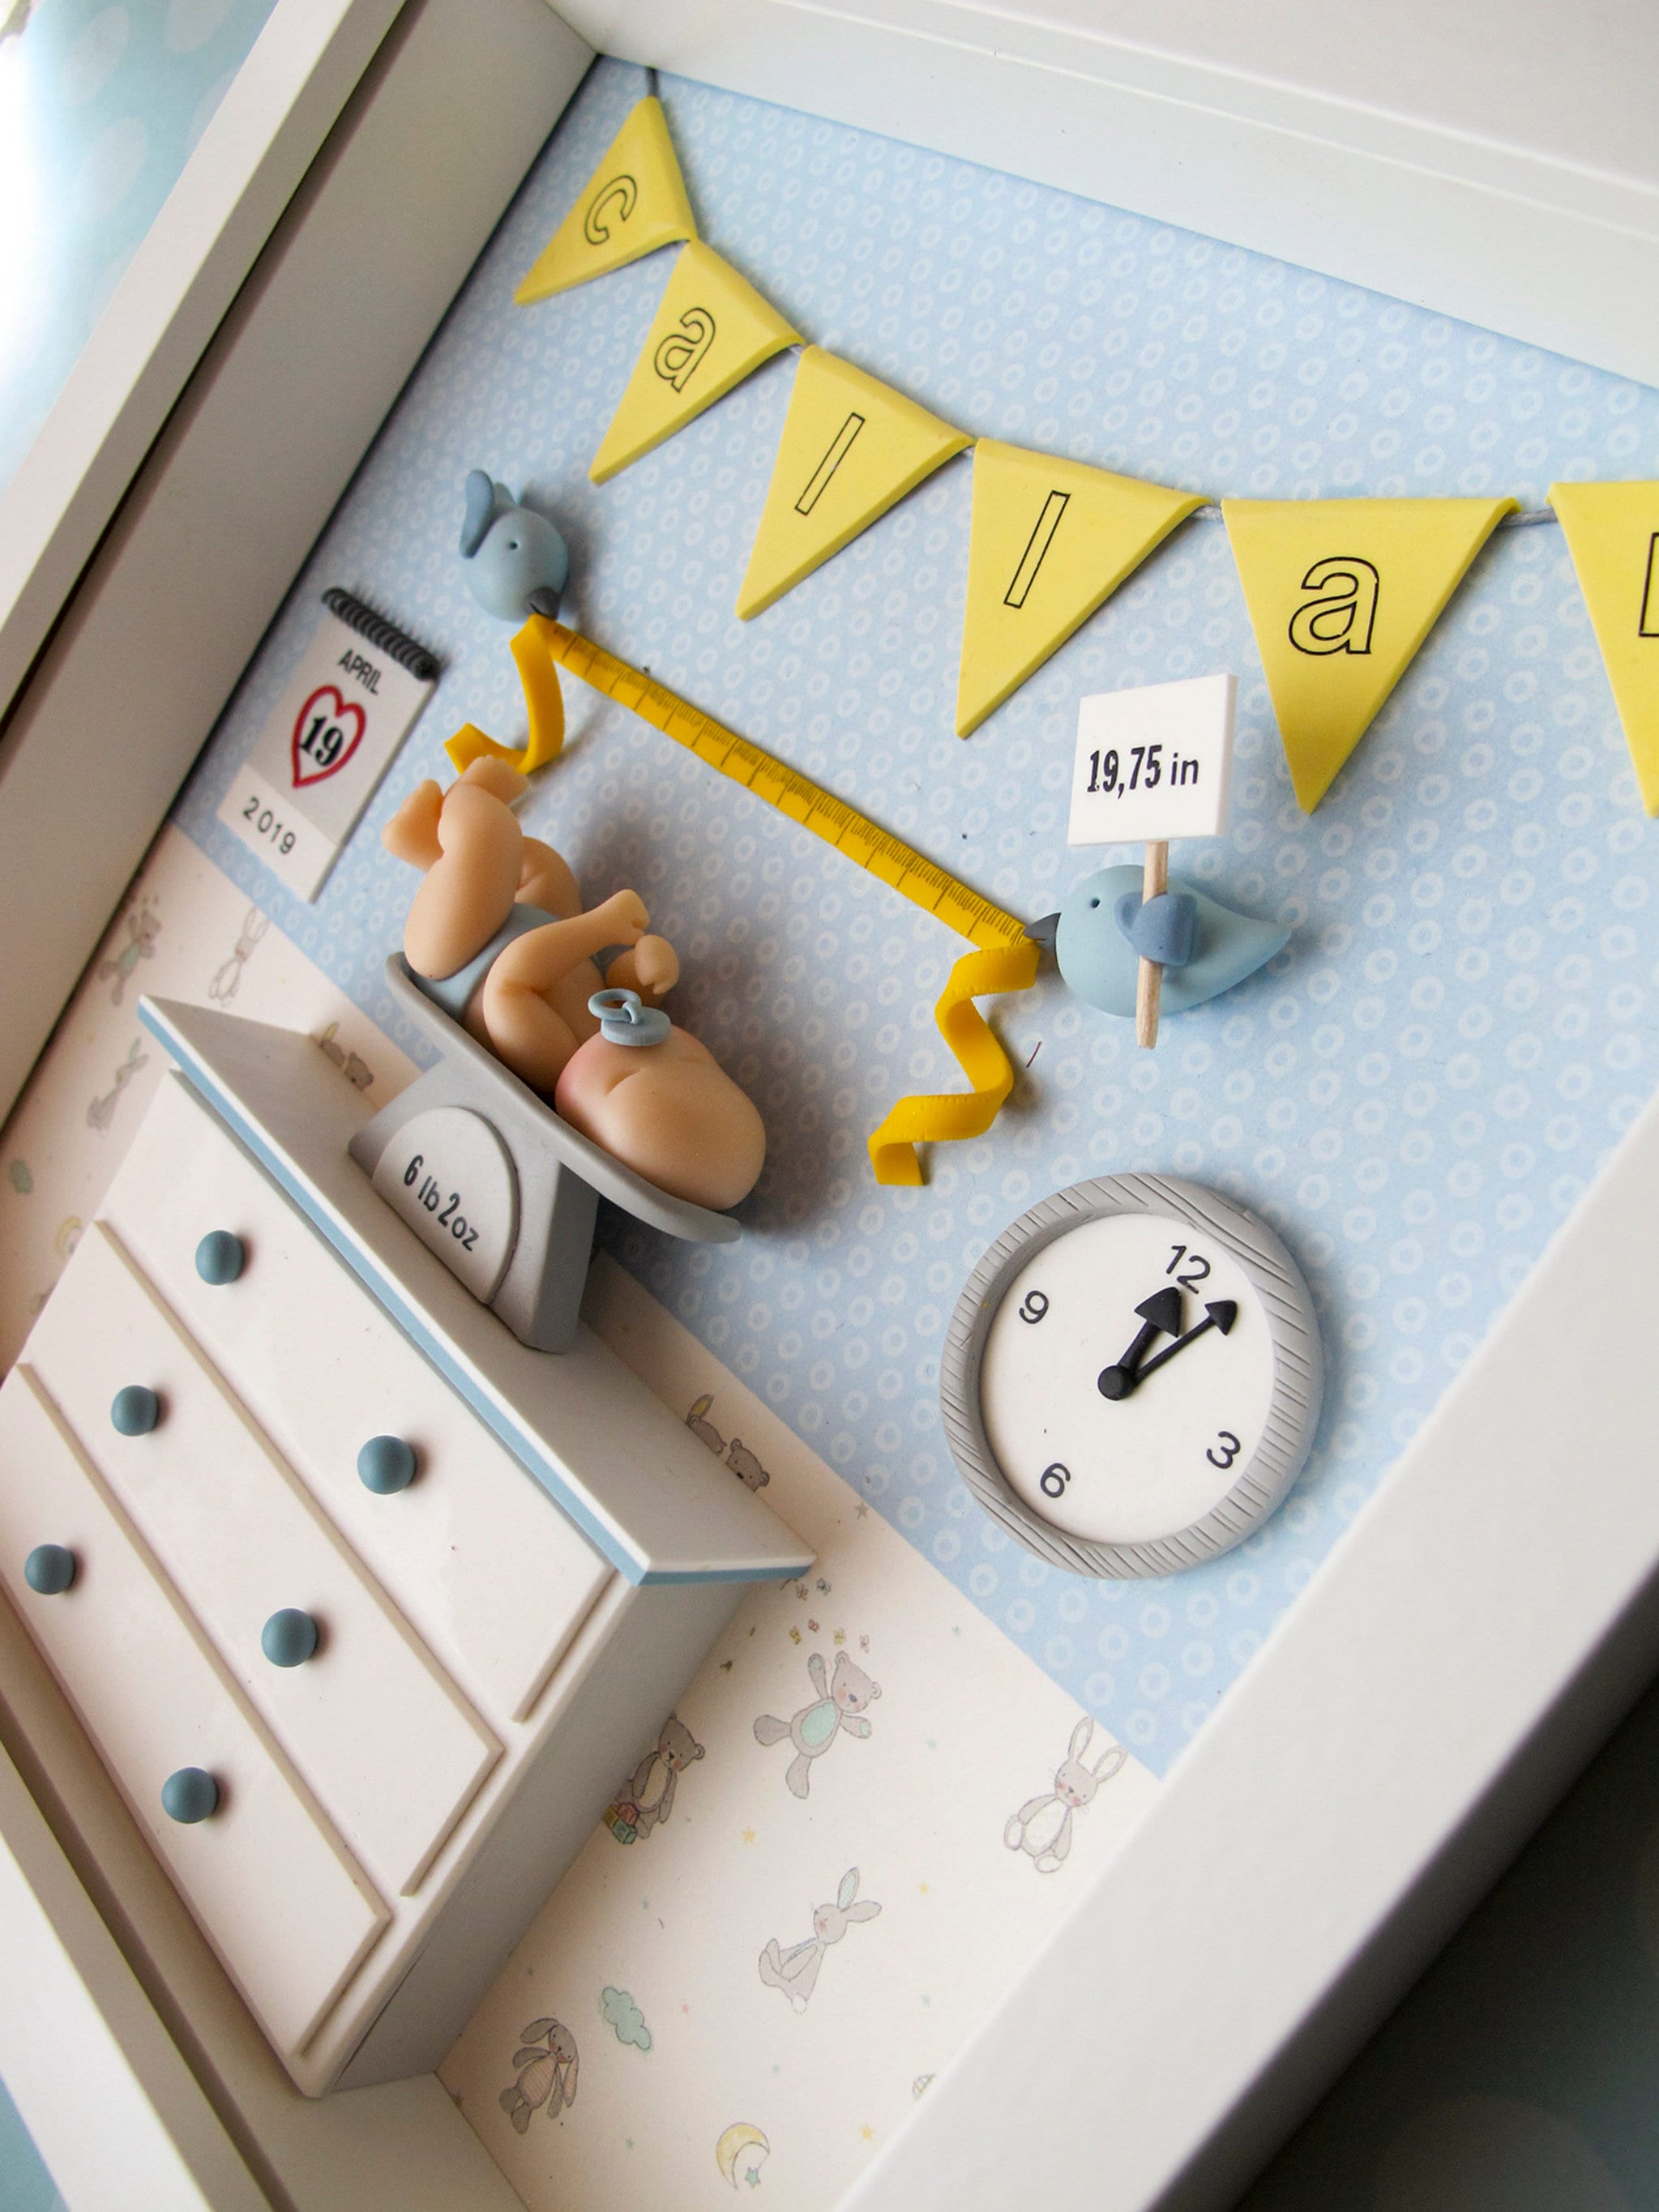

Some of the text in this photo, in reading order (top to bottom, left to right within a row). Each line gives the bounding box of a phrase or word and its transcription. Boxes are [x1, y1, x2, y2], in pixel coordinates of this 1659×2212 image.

[337, 649, 382, 695] APRIL
[298, 715, 344, 767] 19
[1087, 744, 1199, 800] 19,75 in
[242, 796, 297, 855] 2019
[404, 1155, 424, 1186] 6
[417, 1176, 441, 1212] lb
[1165, 1245, 1212, 1295] 12
[1019, 1290, 1050, 1324] 9
[1206, 1431, 1241, 1469] 3
[1040, 1463, 1071, 1498] 6
